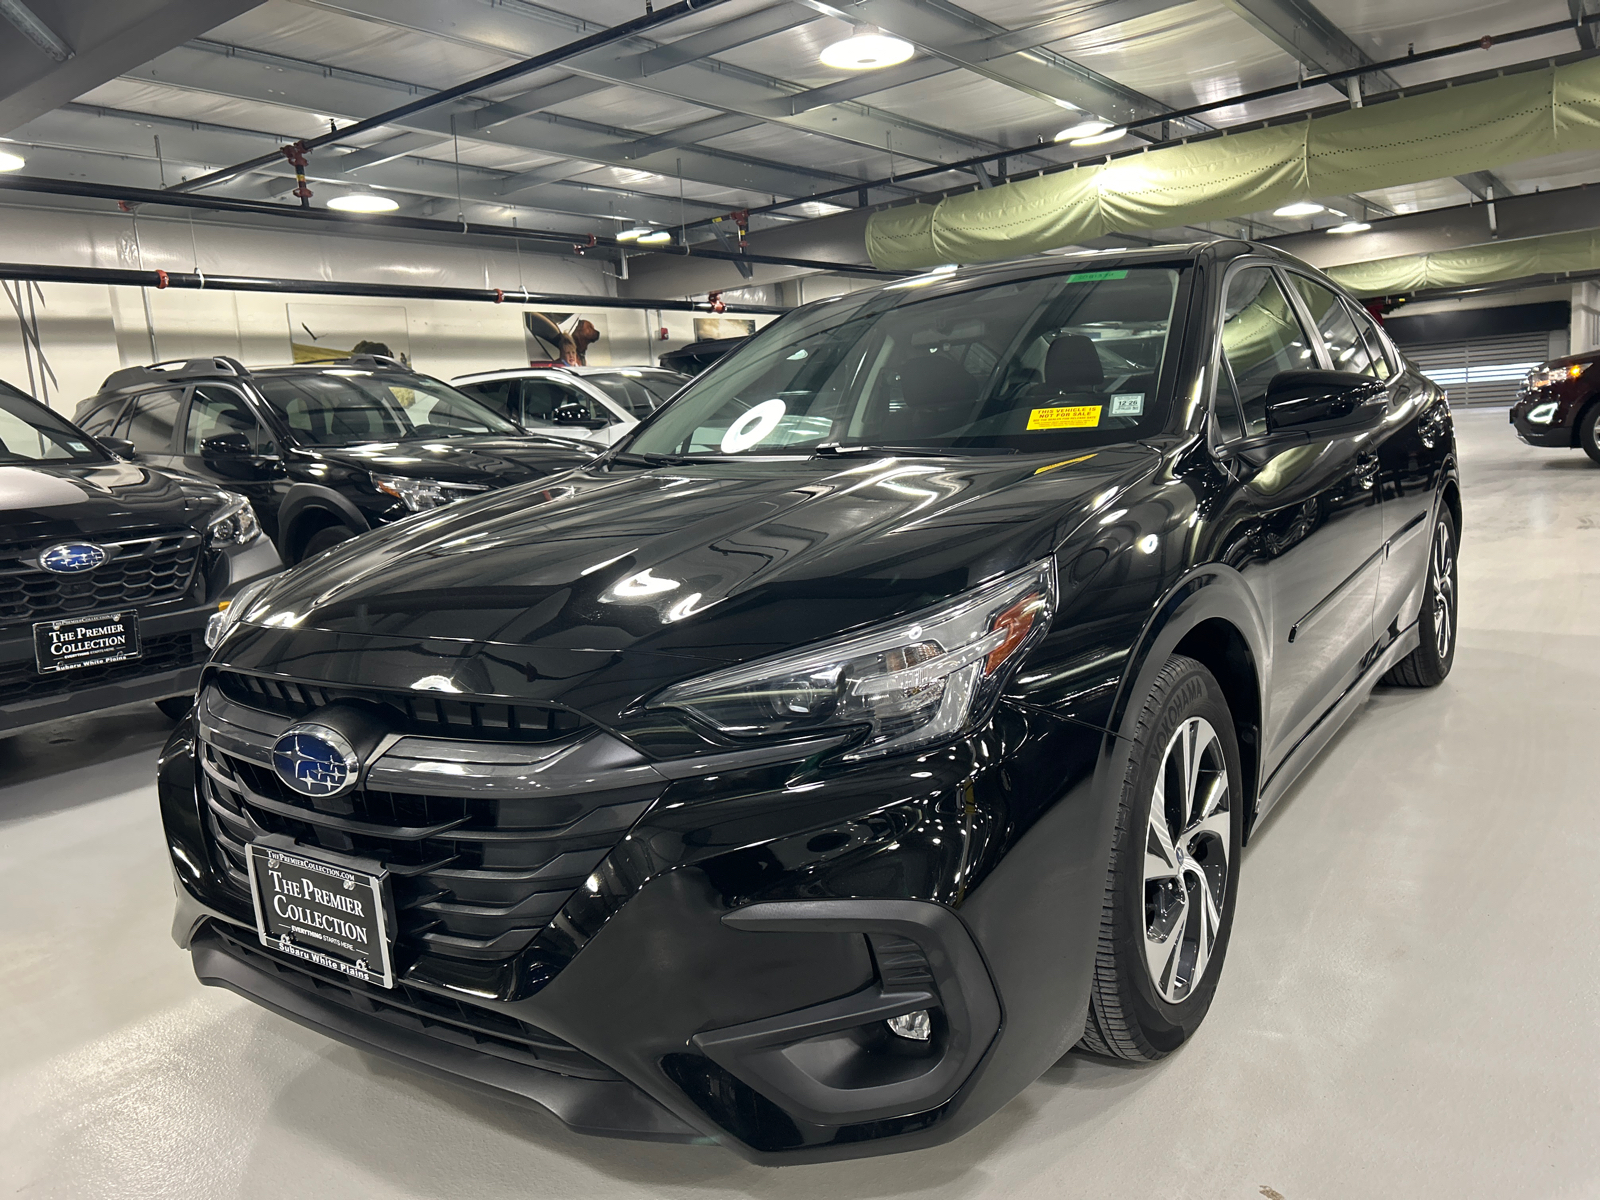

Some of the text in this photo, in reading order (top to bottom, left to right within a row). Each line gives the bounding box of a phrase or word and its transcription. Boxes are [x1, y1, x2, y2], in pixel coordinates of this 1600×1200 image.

[49, 624, 124, 643] THE PREMIER
[50, 635, 126, 655] COLLECTION
[56, 655, 127, 671] Subaru White Plains
[1151, 677, 1203, 760] YOKOHAMA
[268, 869, 365, 917] THE PREMIER
[273, 894, 368, 944] COLLECTION
[291, 925, 323, 940] EVERYTHING
[322, 934, 340, 946] STARTS
[278, 942, 370, 981] Subaru White Plains
